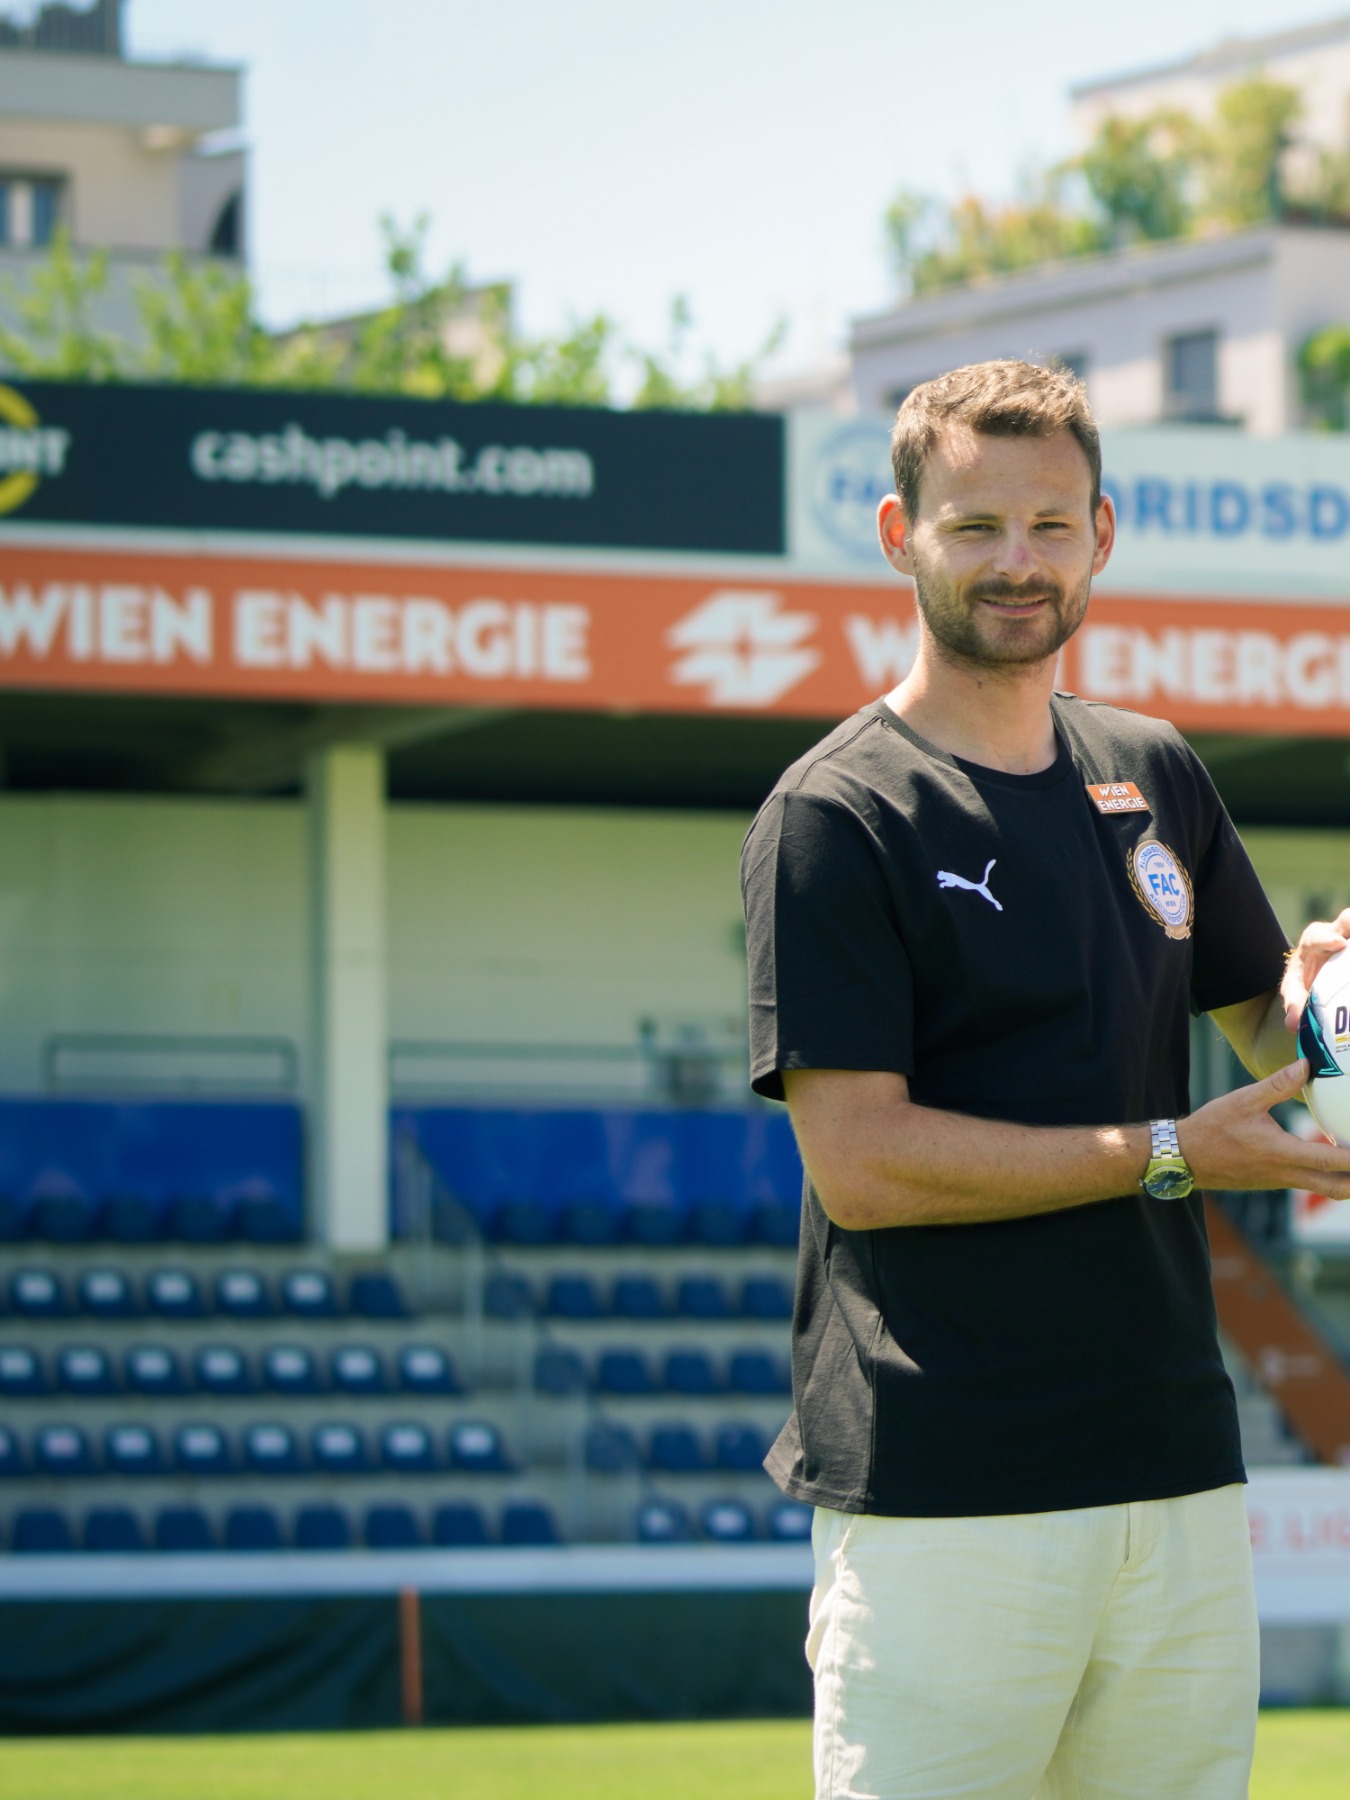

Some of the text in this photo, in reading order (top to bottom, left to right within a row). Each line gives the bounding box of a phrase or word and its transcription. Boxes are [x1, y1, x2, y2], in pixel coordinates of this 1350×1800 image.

[193, 423, 595, 498] cashpoint.com
[0, 582, 591, 682] WIEN ENERGIE
[1099, 785, 1130, 797] WIEN
[1097, 797, 1147, 811] ENERGIE
[1148, 873, 1180, 897] FAC
